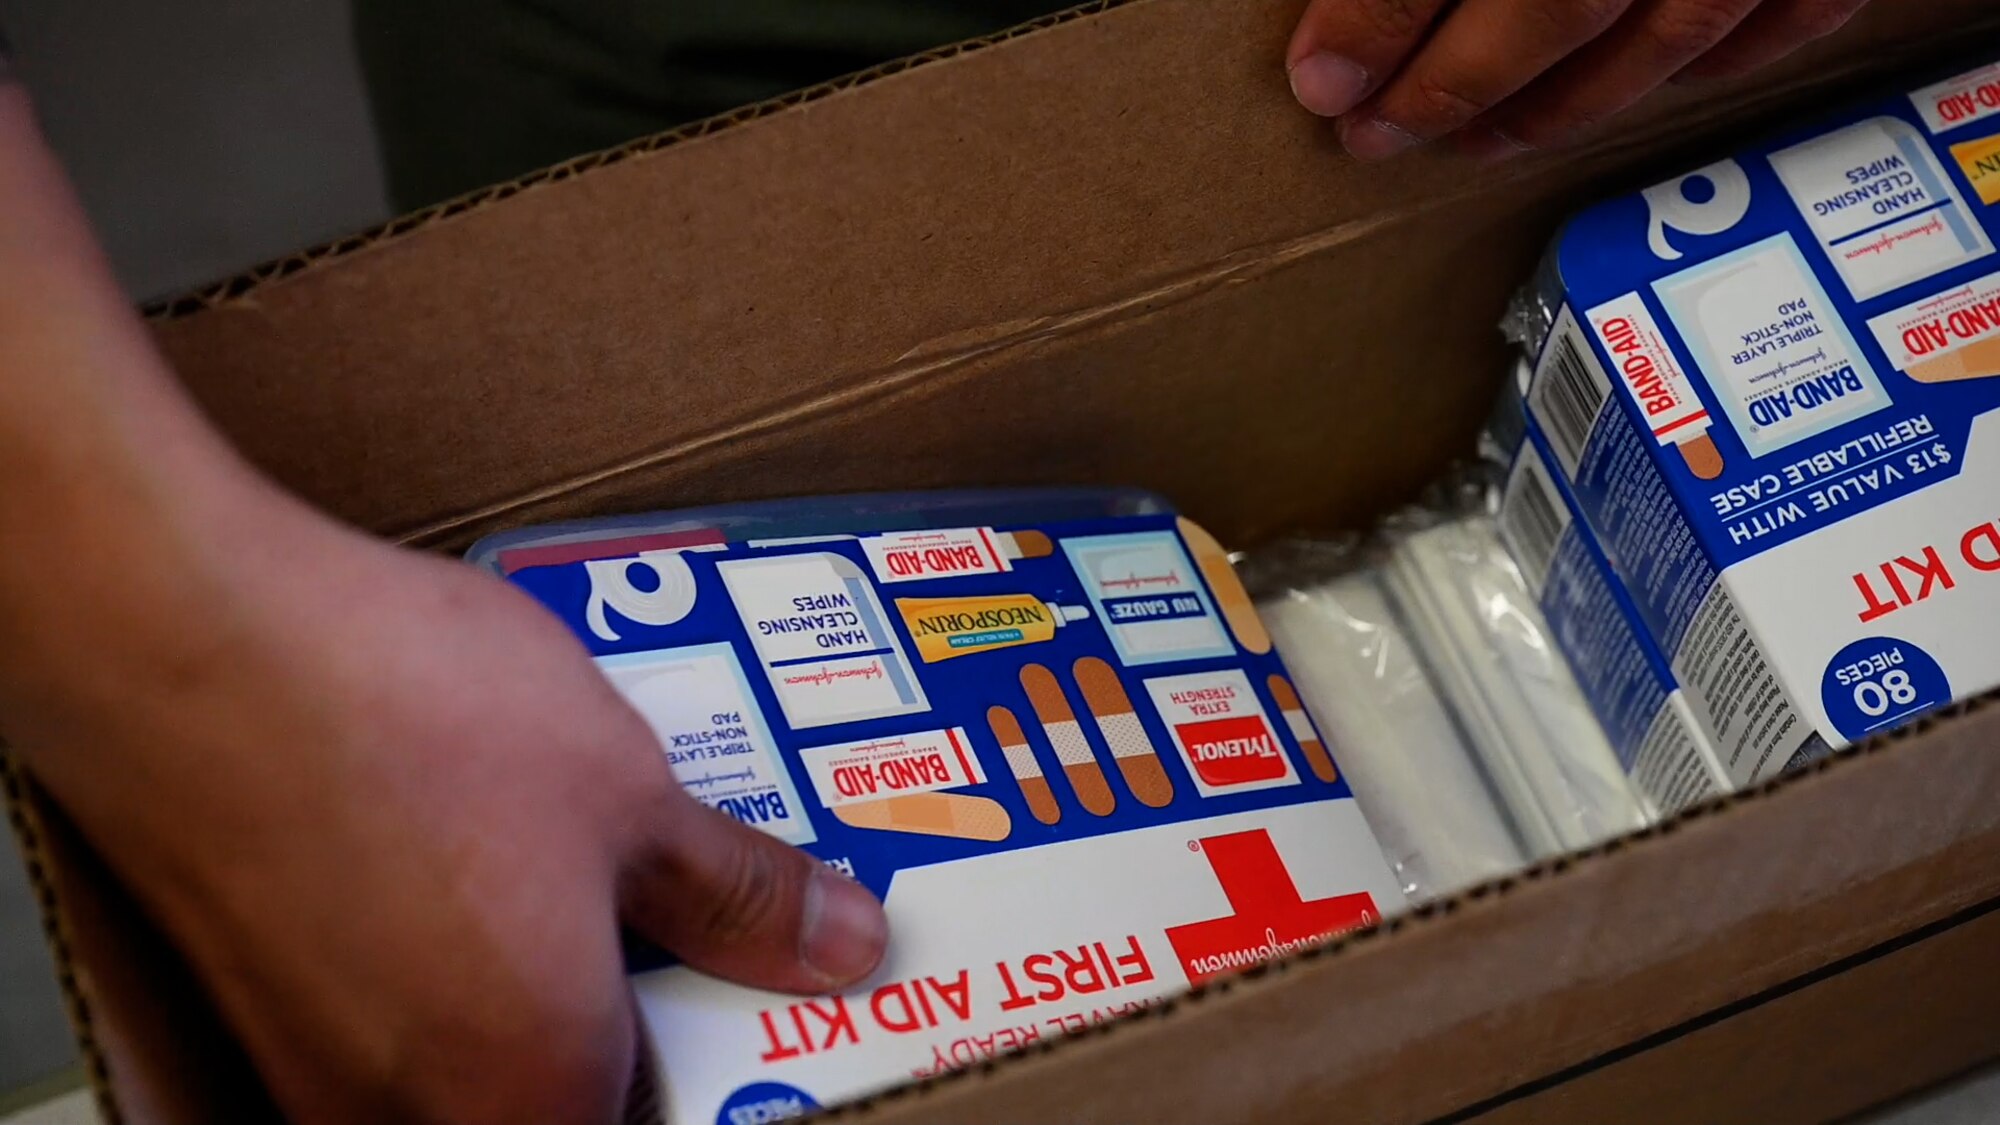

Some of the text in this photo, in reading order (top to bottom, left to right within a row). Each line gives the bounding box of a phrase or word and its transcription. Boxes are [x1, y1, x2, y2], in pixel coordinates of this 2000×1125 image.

[1937, 81, 2000, 122] ND-AID
[1845, 155, 1905, 185] WIPES
[1813, 171, 1914, 216] CLEANSING
[1872, 187, 1925, 215] HAND
[1778, 298, 1807, 315] PAD
[1741, 310, 1815, 346] NON-STICK
[1903, 296, 2000, 356] AND-AID
[1731, 323, 1824, 365] TRIPLE LAYER
[1602, 318, 1676, 416] BAND-AID
[1748, 365, 1864, 427] BAND-AID
[1710, 414, 1934, 515] REFILLABLE CASE
[1727, 442, 1952, 545] $13 VALUE WITH
[886, 545, 984, 575] BAND-AID
[1852, 545, 1956, 623] KIT
[792, 593, 851, 612] WIPES
[1111, 597, 1200, 619] NU GAUZE
[757, 611, 858, 635] CLEANSING
[918, 605, 1045, 635] NEOSPORIN
[816, 629, 868, 648] HAND
[1835, 647, 1904, 686] PIECES
[1170, 686, 1235, 704] STRENGTH
[1189, 700, 1231, 716] EXTRA
[1853, 669, 1917, 717] 80
[711, 711, 742, 725] PAD
[670, 726, 748, 747] NON-STICK
[1192, 733, 1277, 762] TYLENOL
[666, 741, 755, 765] TRIPLE LAYE
[833, 753, 951, 797] BAND-AID
[759, 935, 1155, 1063] FIRST AID KIT
